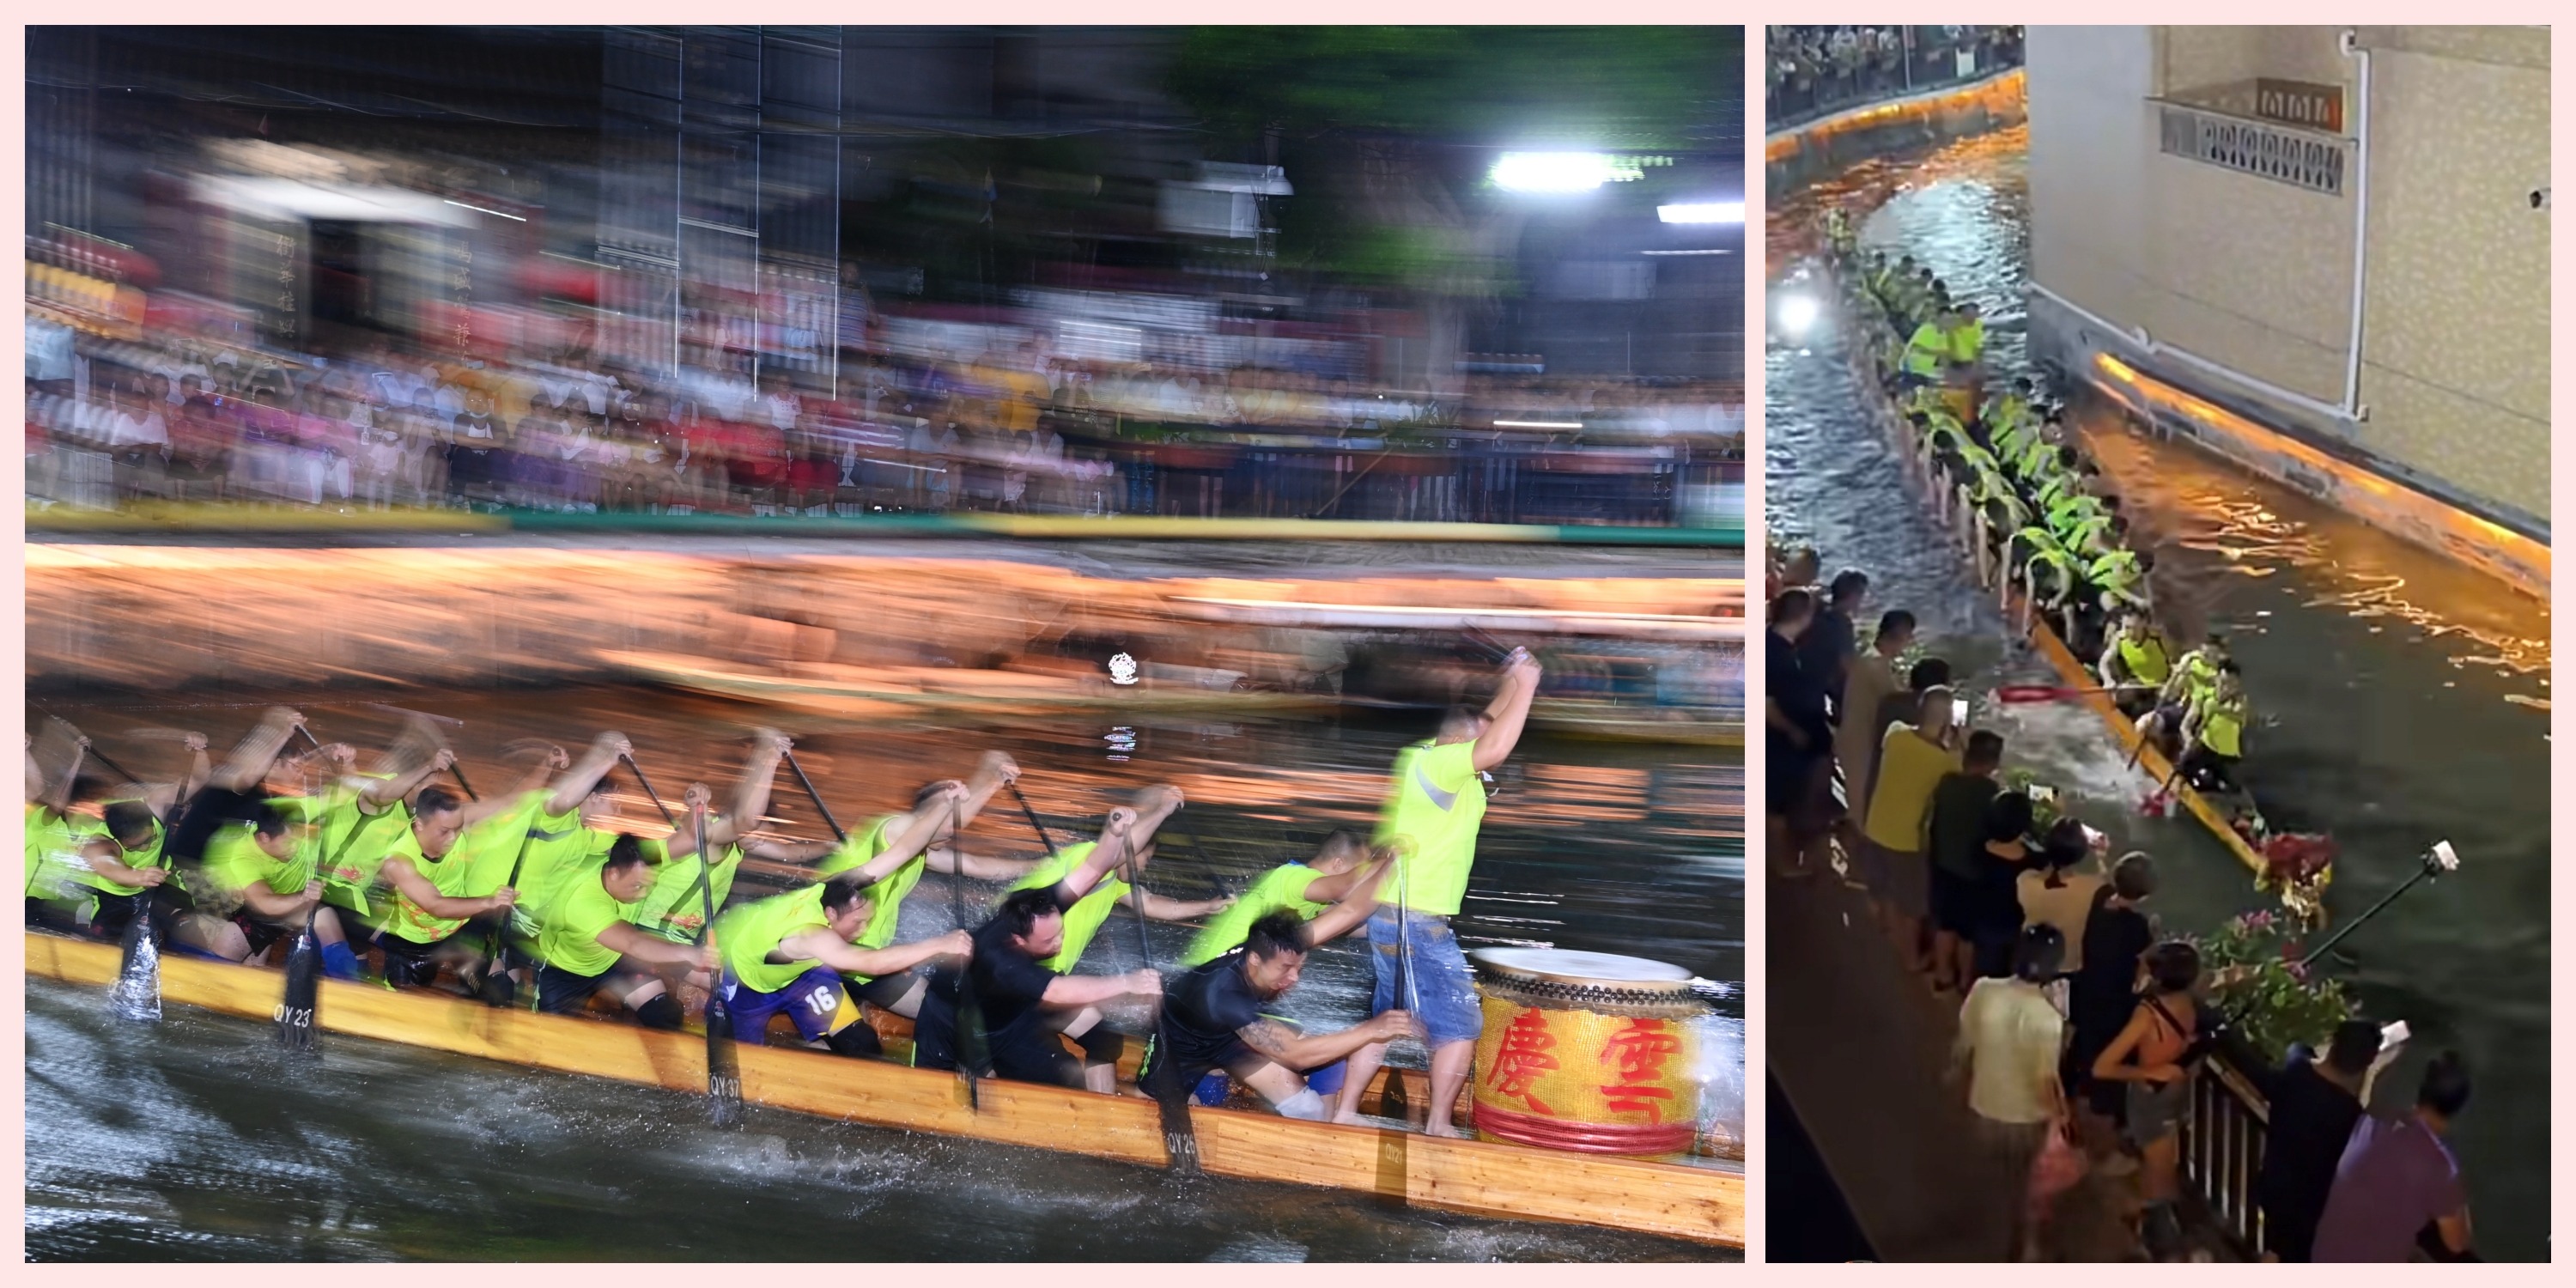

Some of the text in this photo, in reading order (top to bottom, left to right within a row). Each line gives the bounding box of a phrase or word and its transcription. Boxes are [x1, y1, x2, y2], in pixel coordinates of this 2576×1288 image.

[805, 985, 837, 1017] 16
[273, 1003, 310, 1028] QY 23
[711, 1075, 739, 1098] QY 37
[1168, 1132, 1195, 1155] QY 26
